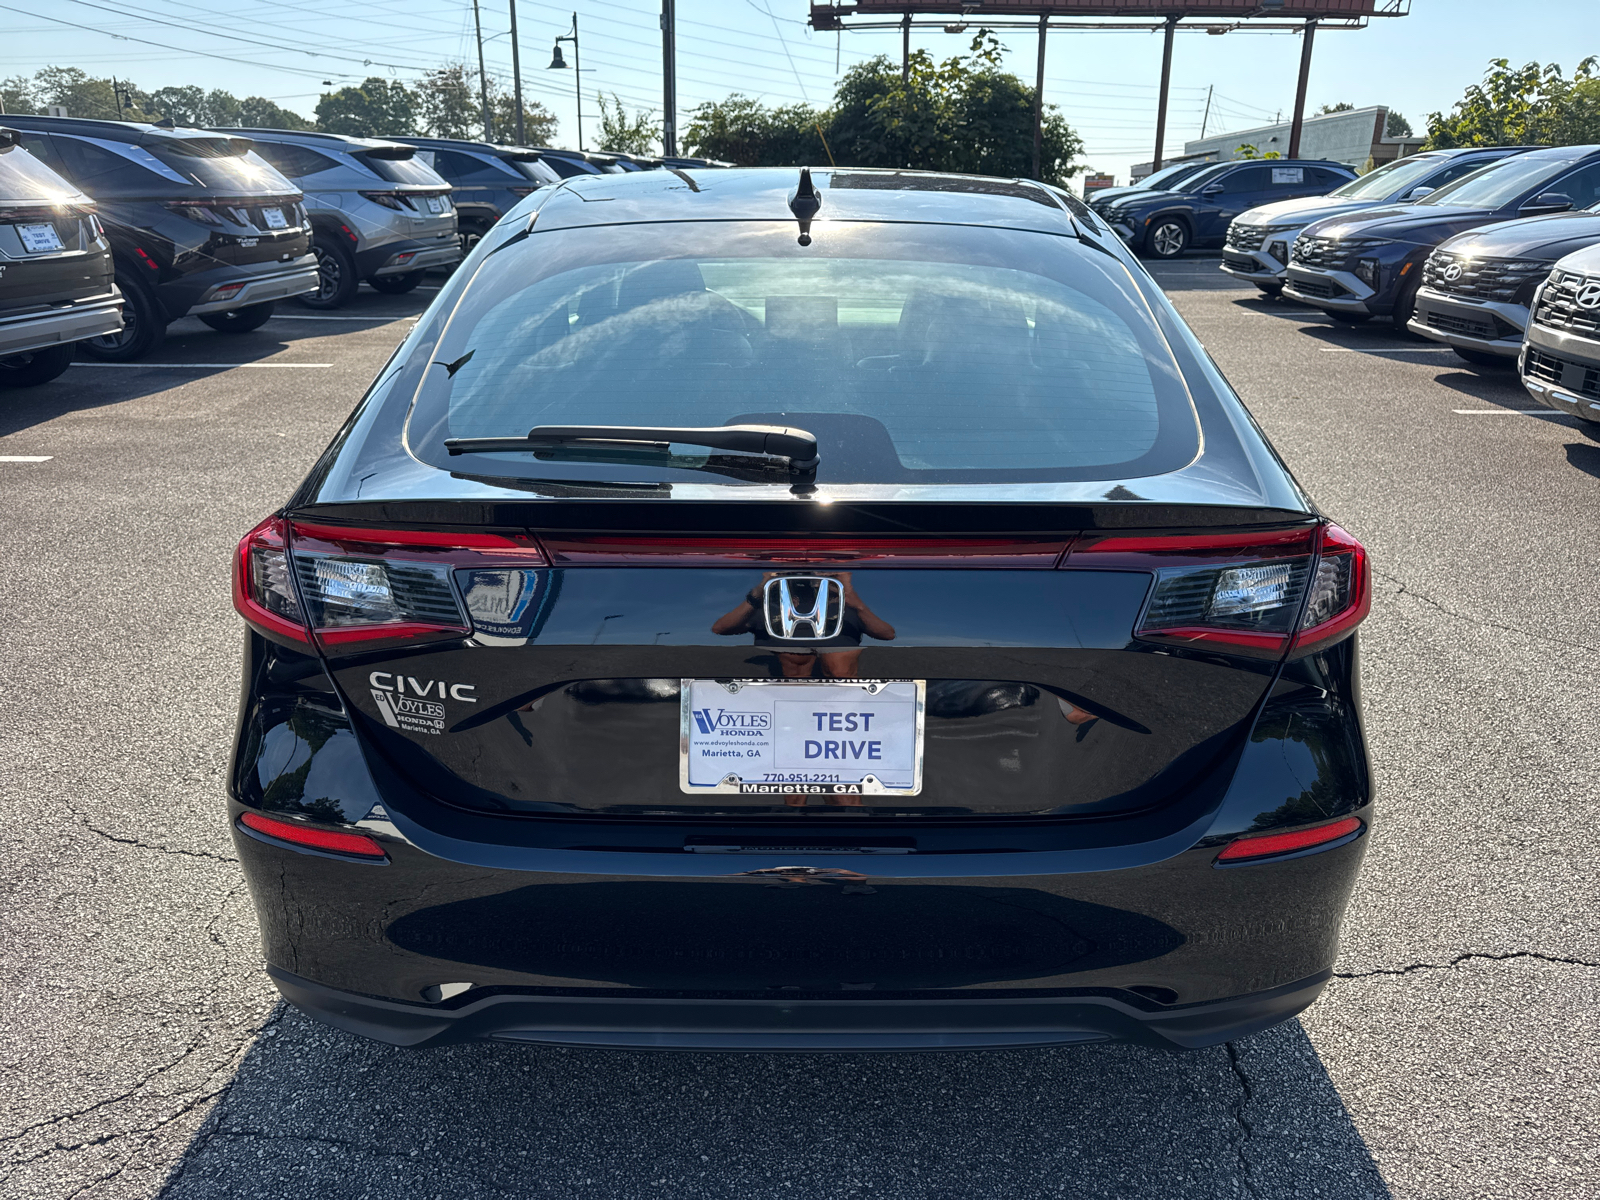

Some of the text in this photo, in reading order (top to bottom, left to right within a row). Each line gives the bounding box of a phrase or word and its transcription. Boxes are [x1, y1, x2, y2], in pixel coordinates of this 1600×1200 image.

[369, 671, 478, 703] CIVIC
[375, 691, 444, 717] ED VOYLES
[396, 714, 435, 727] HONDA
[702, 708, 768, 733] VOYLES
[812, 712, 875, 732] TEST
[401, 723, 442, 736] Marietta, GA
[720, 729, 764, 737] HONDA
[702, 749, 761, 758] Marietta, GA
[804, 739, 882, 760] DRIVE
[763, 773, 841, 783] 770-951-2211
[742, 784, 860, 794] Marietta, GA
